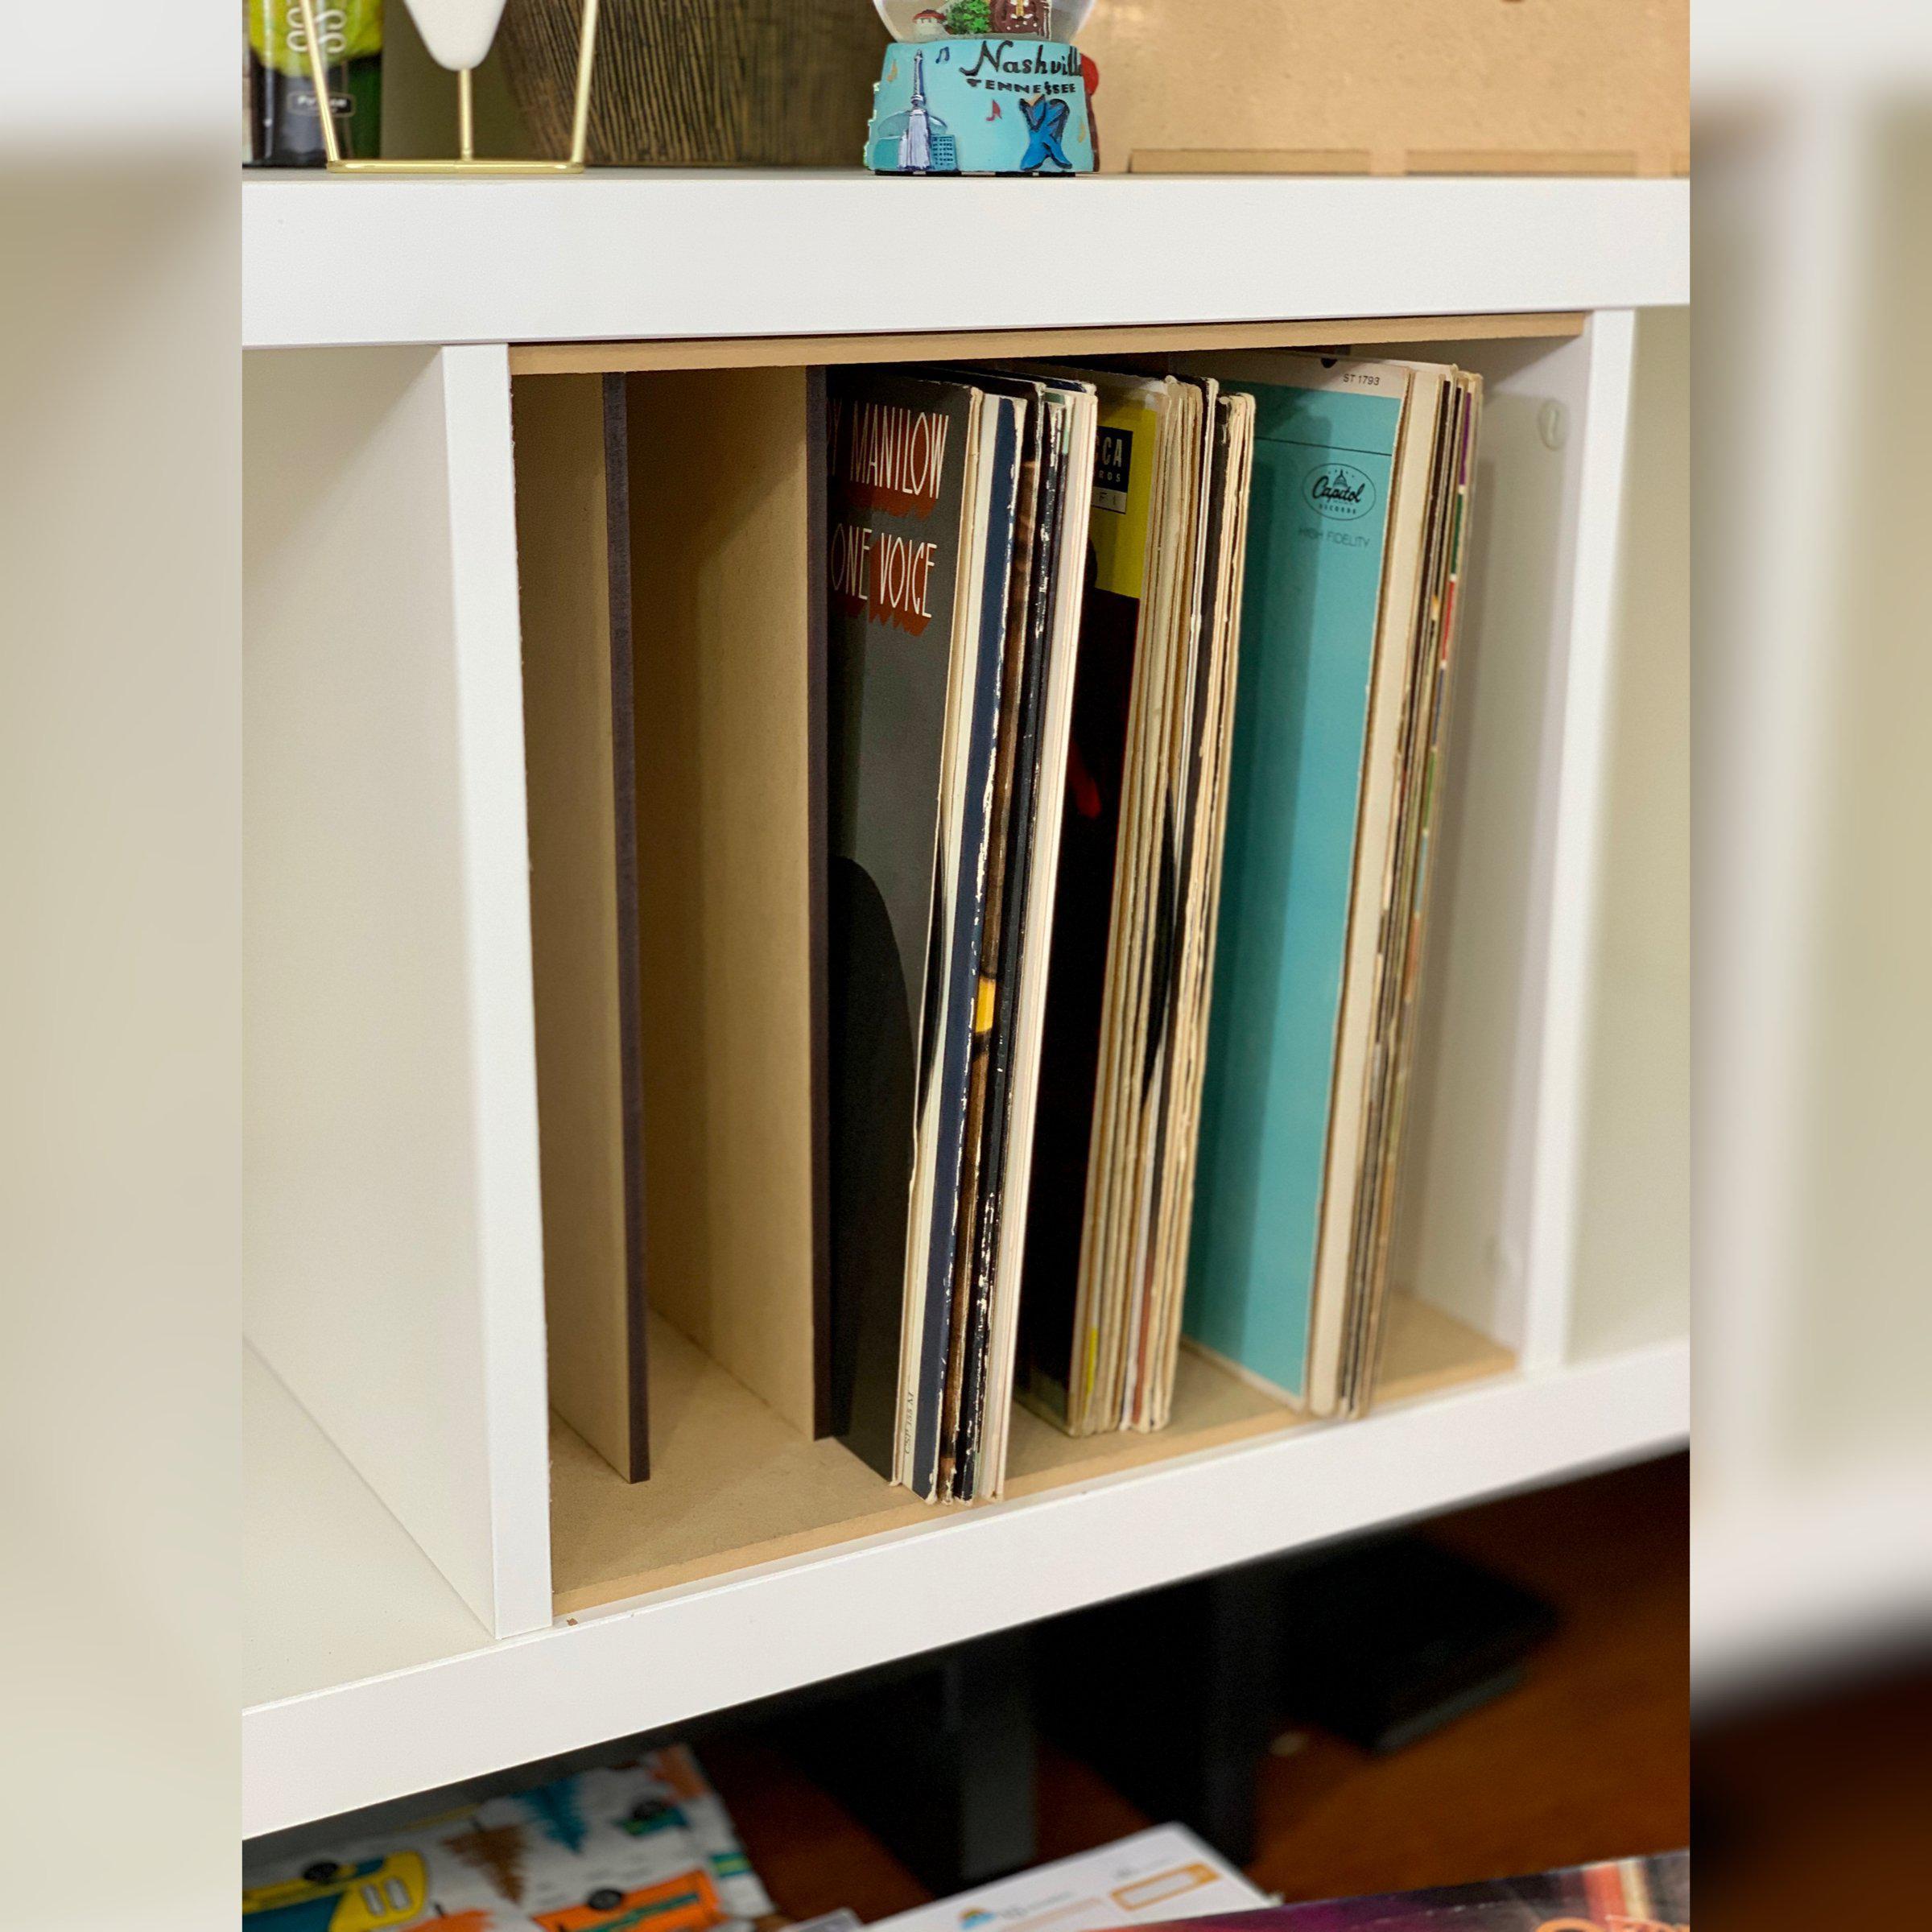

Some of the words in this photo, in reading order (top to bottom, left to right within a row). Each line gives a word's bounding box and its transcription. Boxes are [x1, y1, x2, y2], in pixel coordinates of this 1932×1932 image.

[966, 78, 1076, 95] TENNESSEE
[1343, 373, 1356, 382] ST
[1358, 375, 1380, 386] 1793
[849, 399, 950, 500] MANILOW
[1312, 475, 1365, 503] Capitol
[1319, 503, 1356, 514] RECORDS
[1327, 530, 1370, 547] FIDELITY
[831, 522, 873, 601] ONE
[880, 531, 938, 618] VOICE
